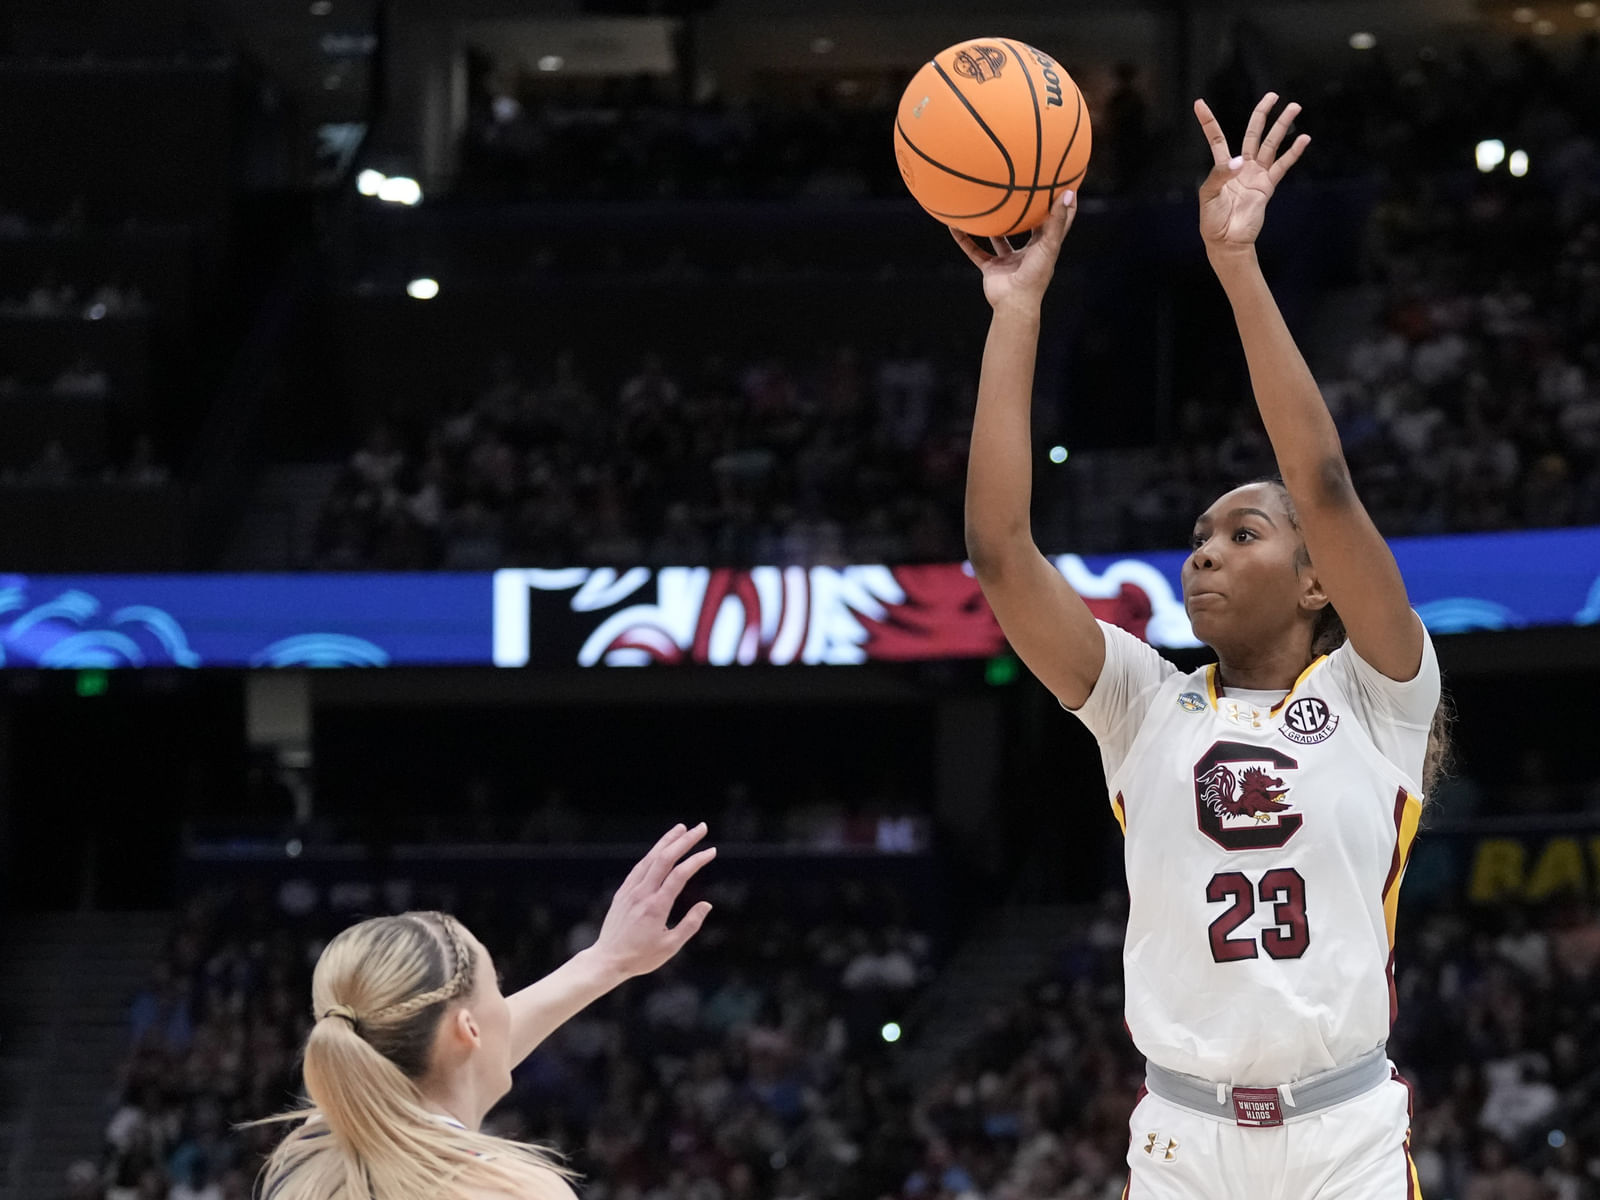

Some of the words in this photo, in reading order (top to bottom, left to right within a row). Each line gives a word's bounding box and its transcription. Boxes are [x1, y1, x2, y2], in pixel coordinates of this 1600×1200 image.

[1288, 699, 1326, 731] SEC
[1288, 724, 1334, 743] GRADUATE
[1206, 867, 1310, 963] 23
[1238, 1101, 1275, 1110] CAROLINA
[1246, 1110, 1271, 1119] SOUTH
